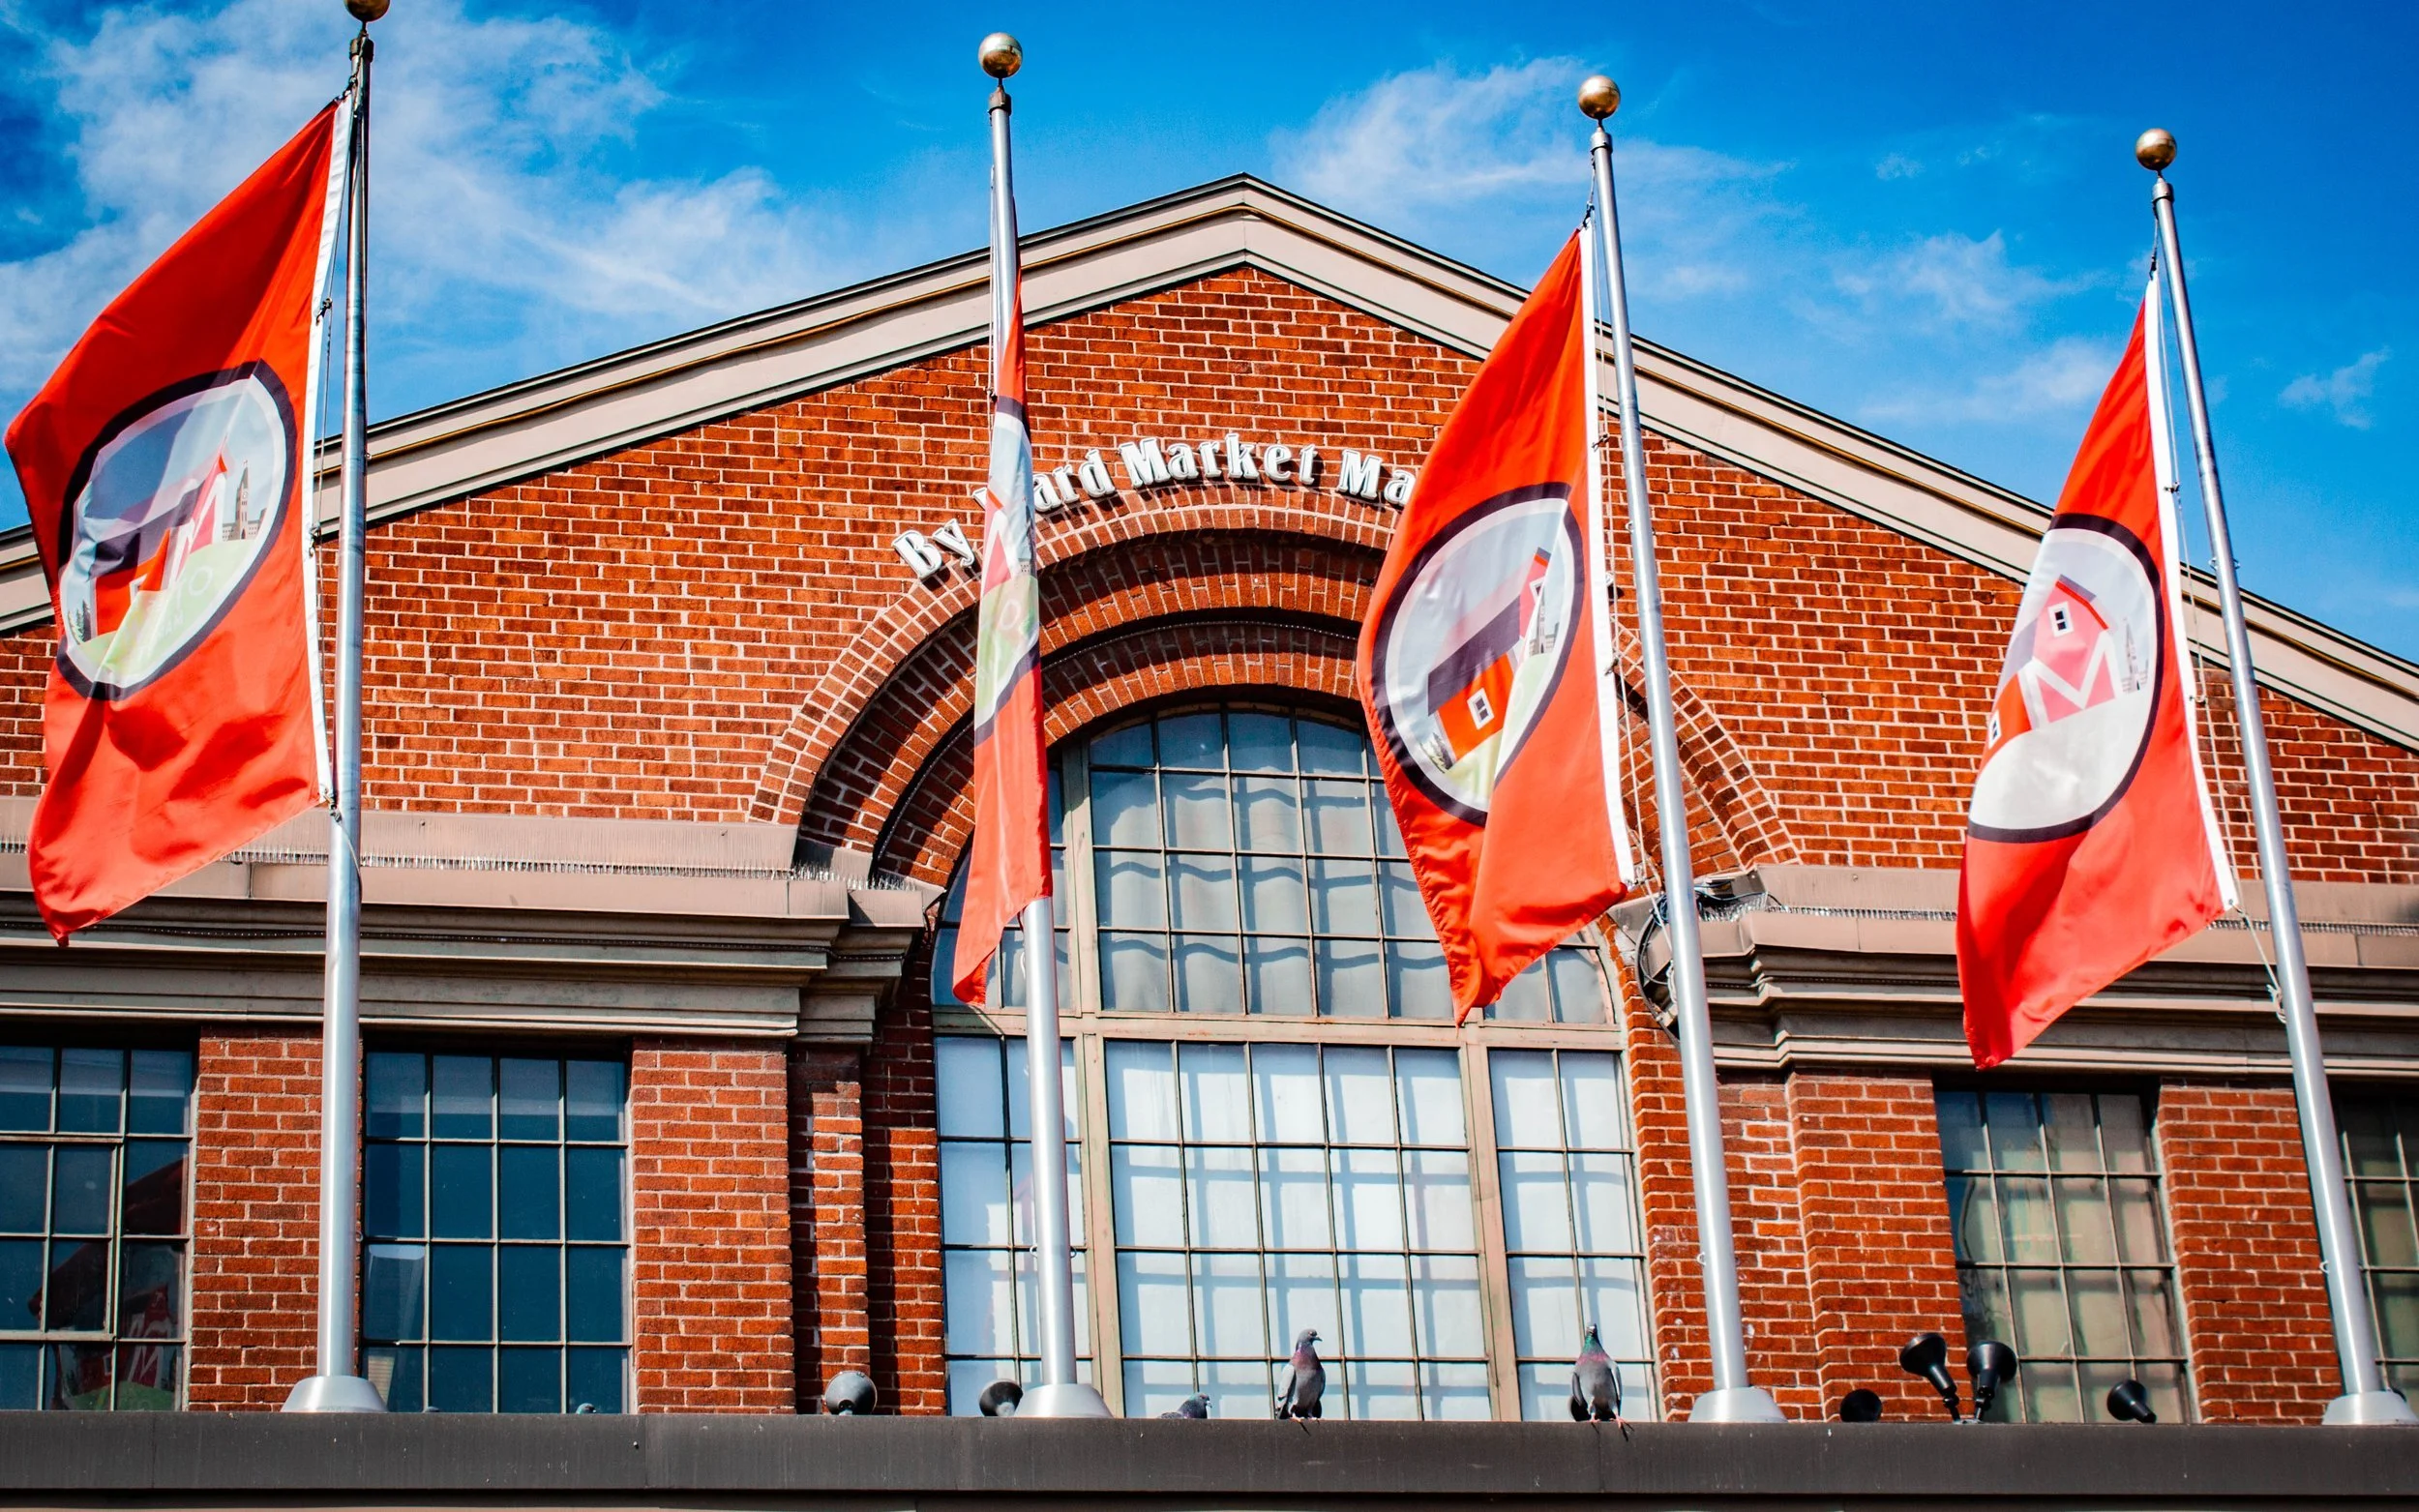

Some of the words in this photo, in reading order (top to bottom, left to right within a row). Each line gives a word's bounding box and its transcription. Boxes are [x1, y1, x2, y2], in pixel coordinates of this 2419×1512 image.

[892, 519, 975, 581] By
[972, 448, 1116, 513] ard
[1119, 432, 1319, 489] Market
